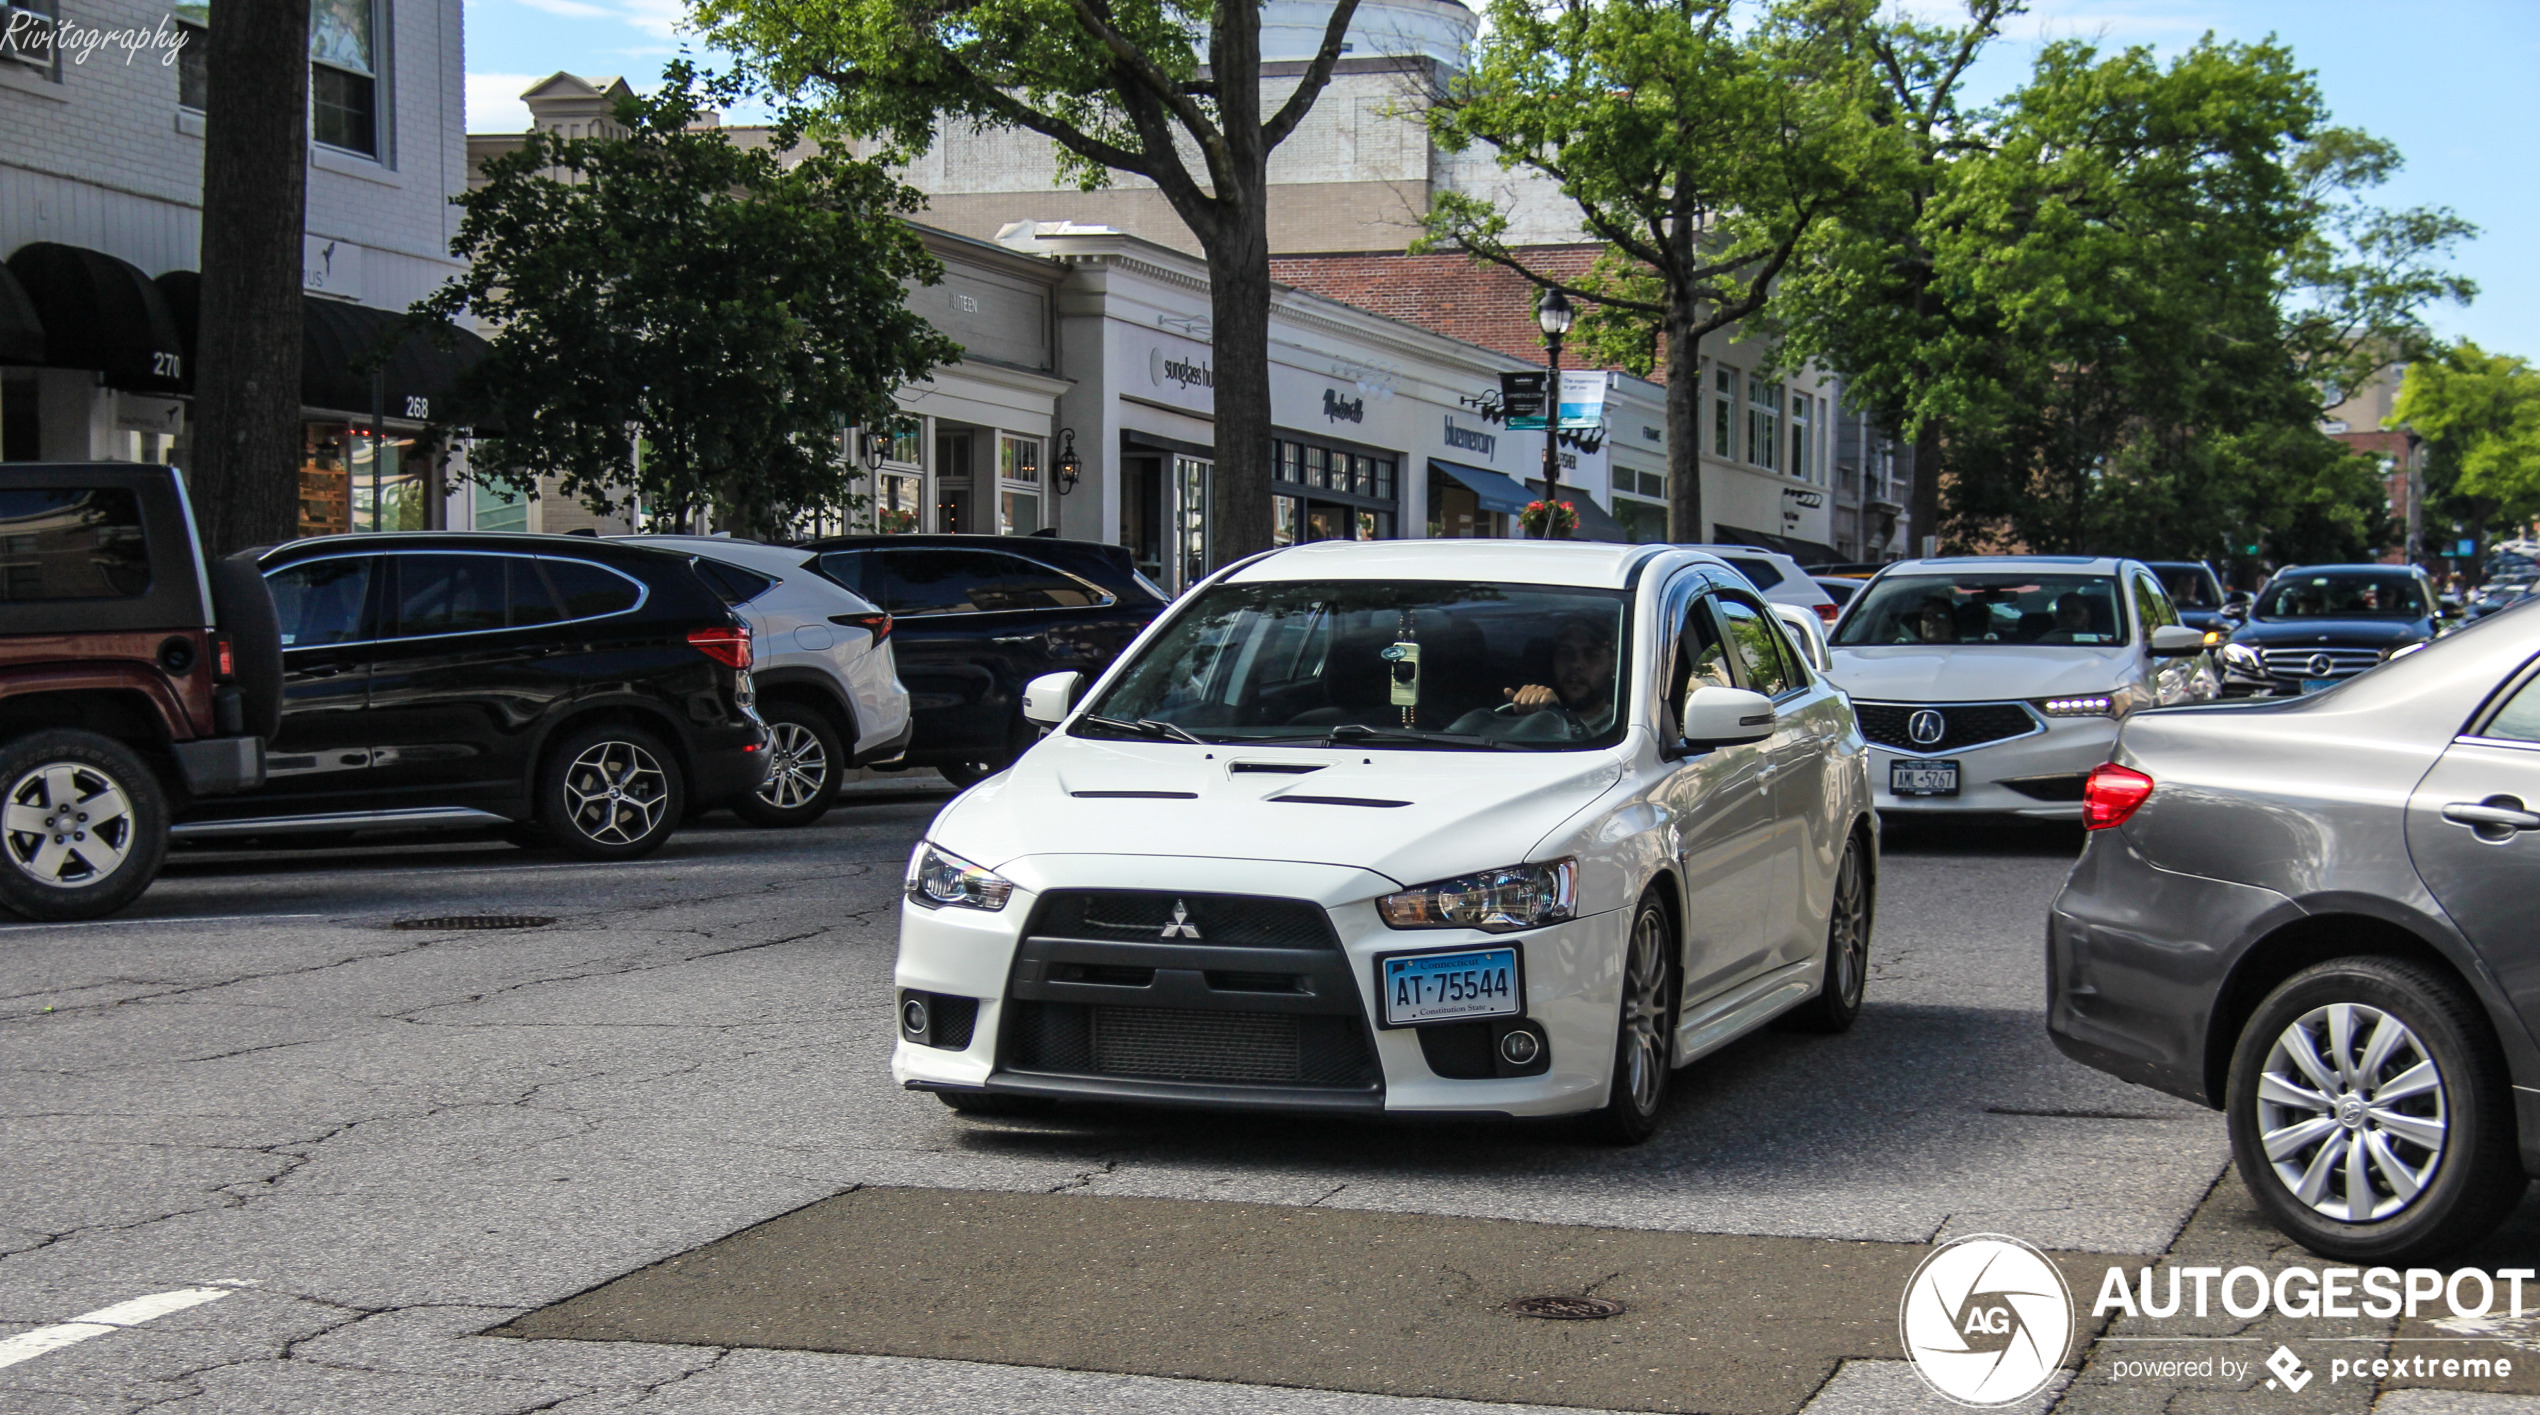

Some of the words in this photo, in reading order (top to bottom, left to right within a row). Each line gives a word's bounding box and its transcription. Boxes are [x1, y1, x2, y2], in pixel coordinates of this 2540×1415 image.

[153, 351, 181, 379] 270
[1164, 356, 1202, 390] sunglass
[406, 396, 429, 419] 268
[1444, 414, 1496, 463] bluemercury
[1925, 771, 1953, 788] 5267
[1420, 958, 1480, 970] Connecticut
[1419, 1006, 1466, 1016] Constitution
[1467, 1003, 1486, 1012] State
